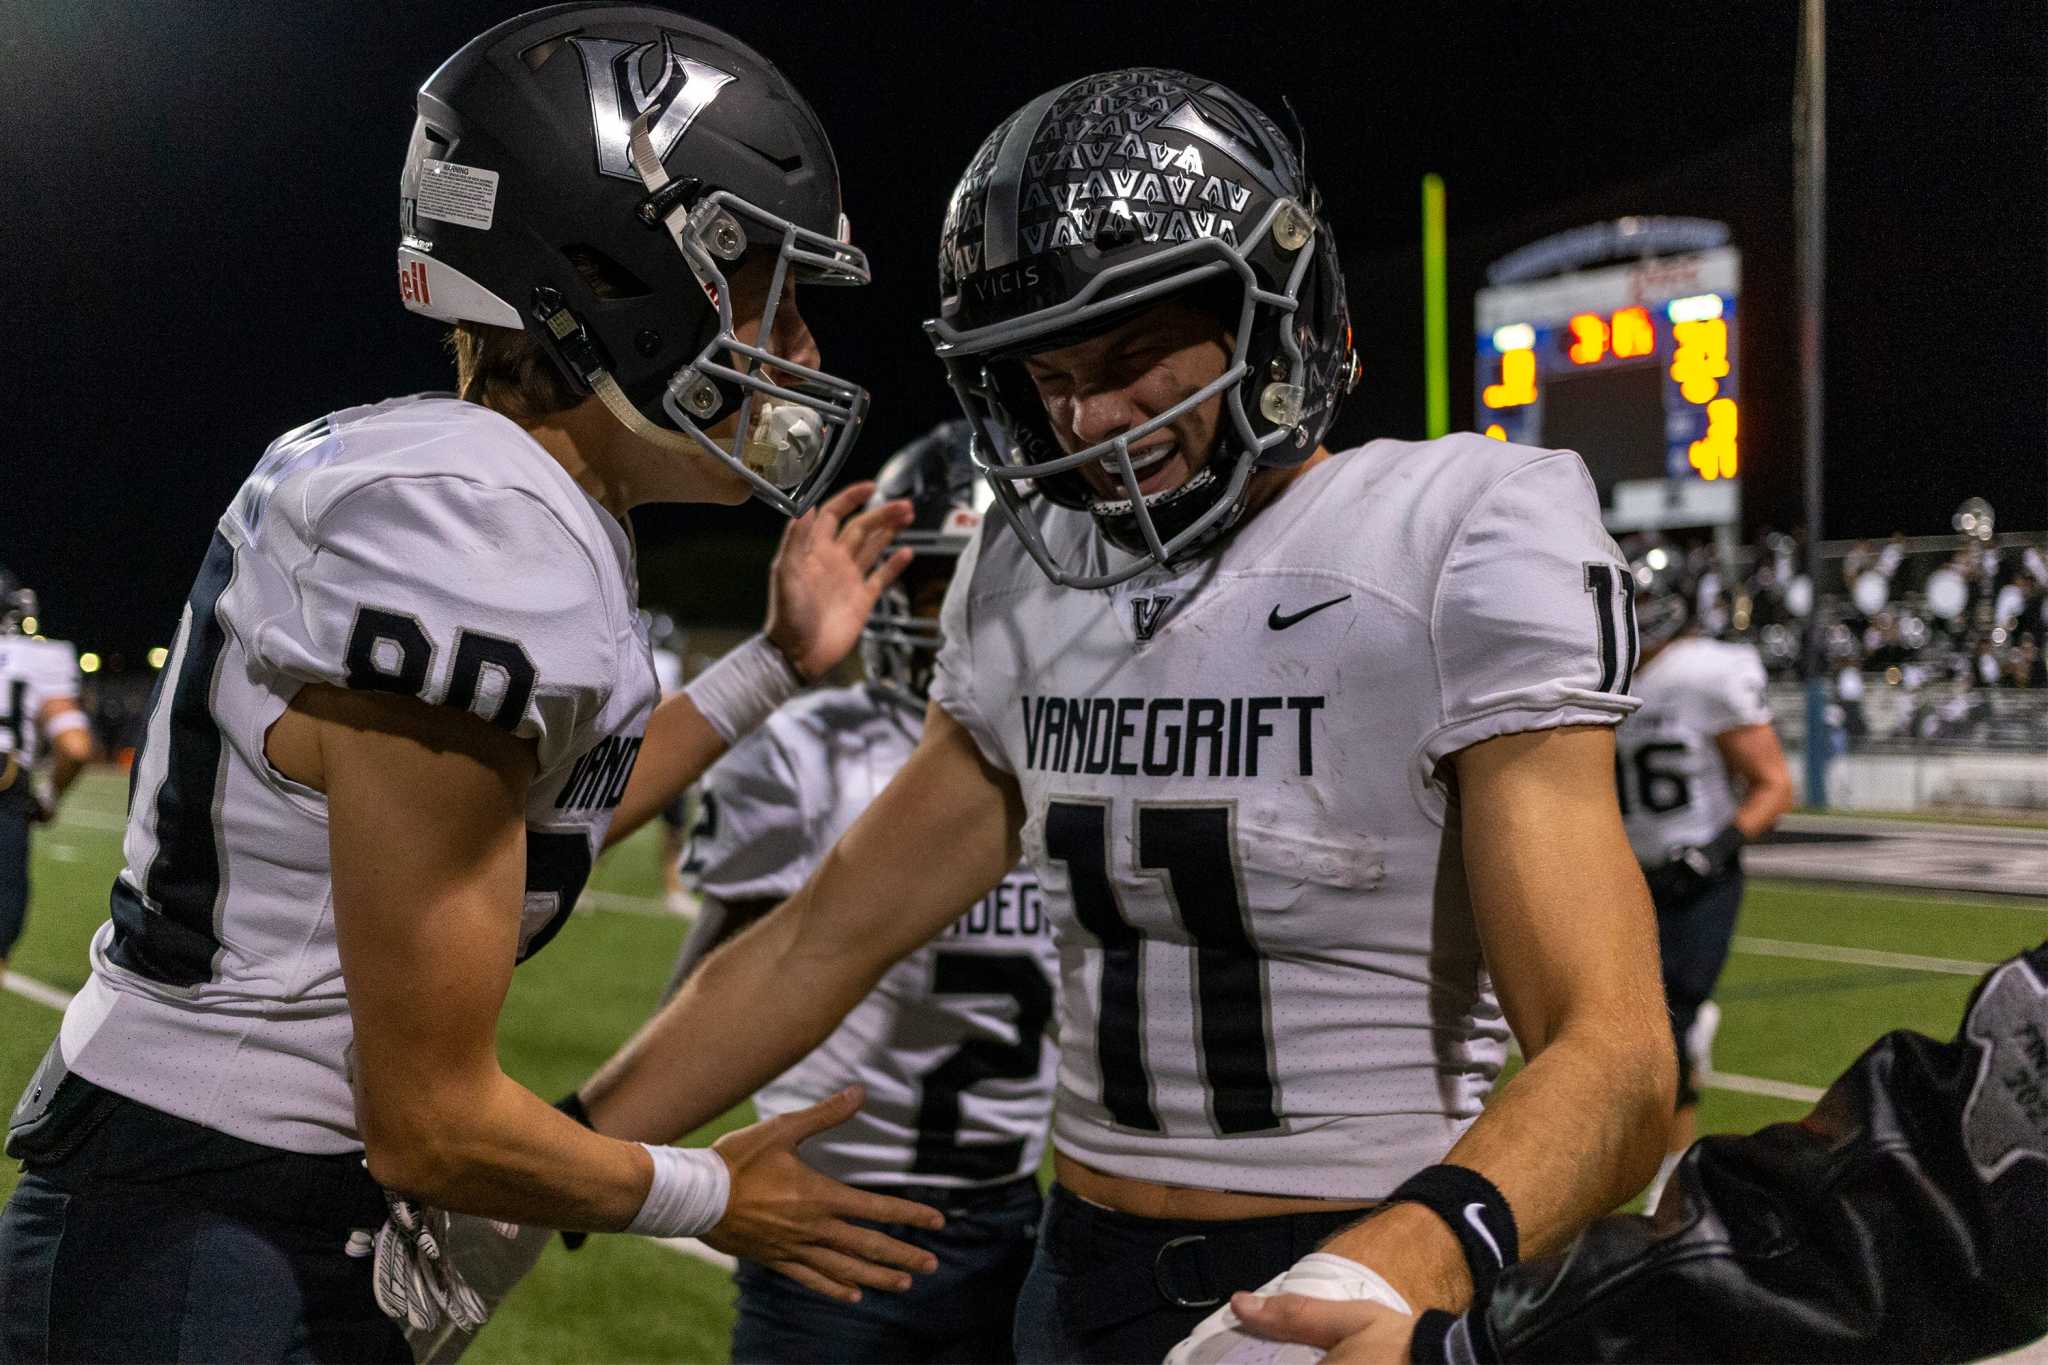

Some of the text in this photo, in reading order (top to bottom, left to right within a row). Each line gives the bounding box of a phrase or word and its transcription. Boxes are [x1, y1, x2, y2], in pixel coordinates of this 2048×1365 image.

[976, 265, 1040, 300] VICIS
[1584, 561, 1640, 696] 11
[1021, 696, 1325, 777] VANDEGRIFT
[953, 882, 1051, 935] DEG
[1045, 798, 1286, 1136] 11
[913, 950, 1056, 1180] 2
